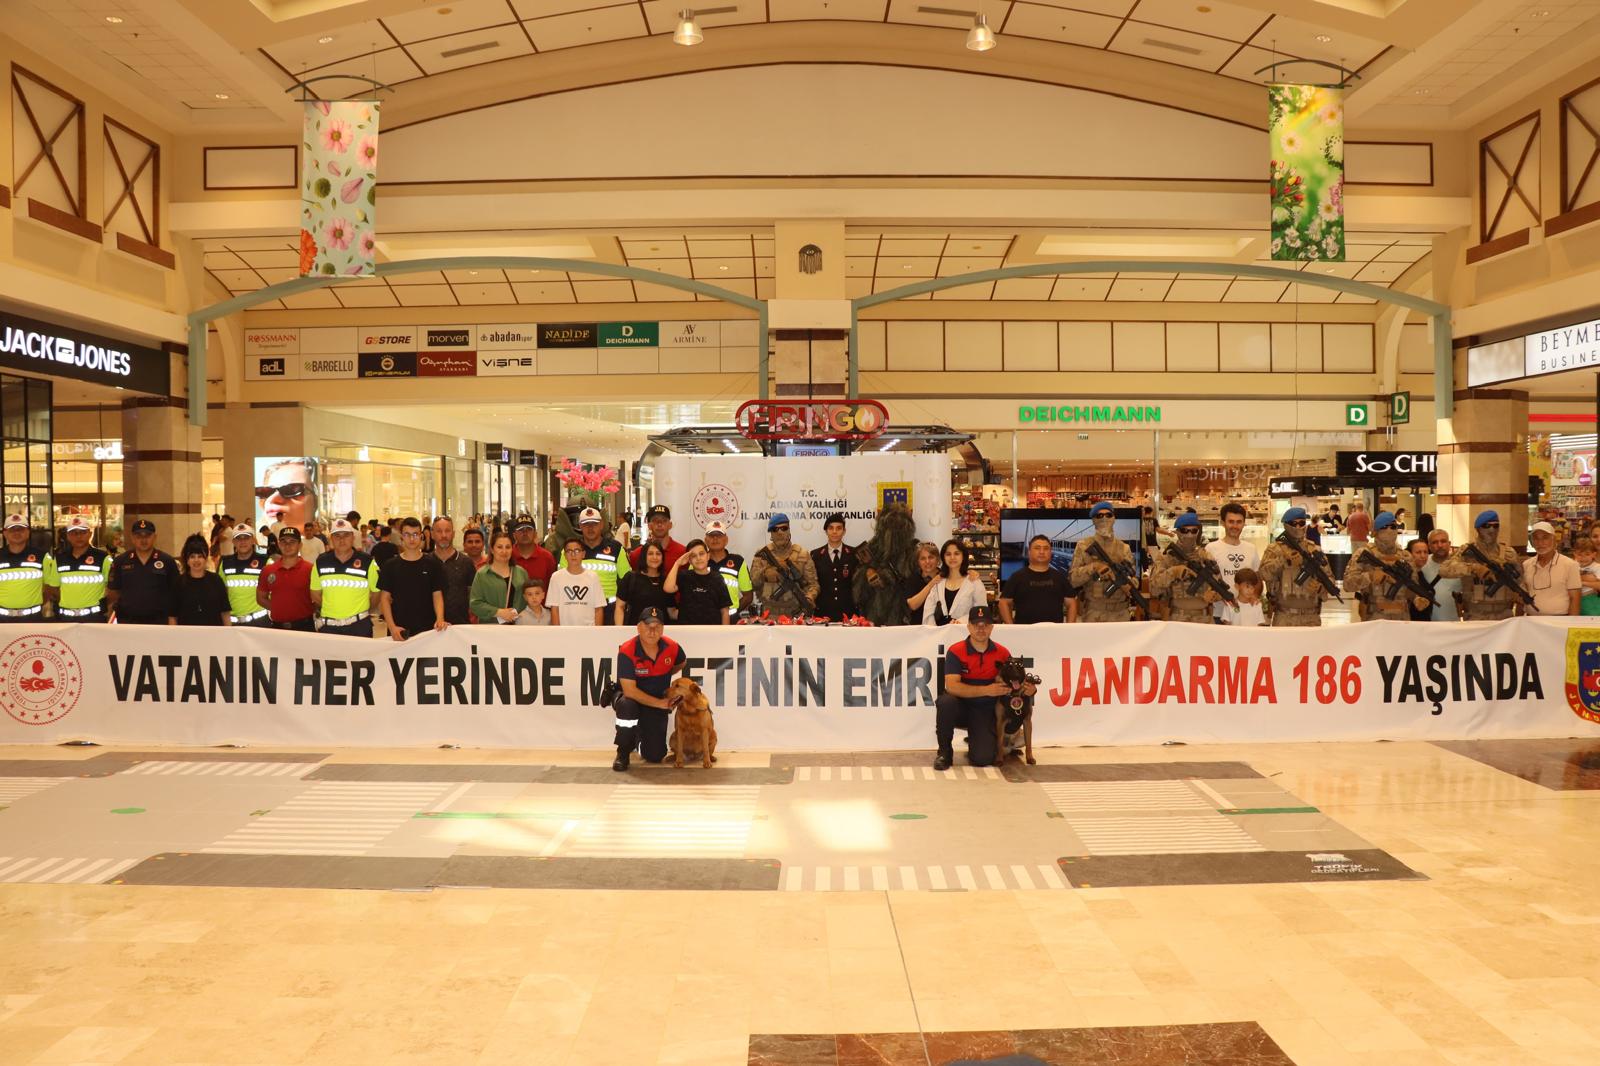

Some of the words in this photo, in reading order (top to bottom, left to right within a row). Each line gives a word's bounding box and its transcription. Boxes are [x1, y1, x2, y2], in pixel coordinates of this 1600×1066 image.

[248, 334, 296, 343] ROSSMANN
[428, 334, 469, 343] morven
[0, 326, 54, 361] JACK
[75, 344, 131, 376] JONES
[312, 360, 353, 372] BARGELLO
[1540, 350, 1598, 370] BUSINE
[1394, 395, 1406, 416] D
[1019, 406, 1161, 422] DEICHMANN
[1350, 407, 1365, 422] D
[1394, 454, 1437, 473] CHI
[800, 490, 818, 498] T.C.
[770, 501, 803, 509] ADANA
[806, 499, 847, 508] VALİLİĞİ
[741, 510, 750, 520] İL
[108, 654, 279, 705] VATANIN
[294, 658, 376, 705] HER
[389, 644, 566, 705] YERİNDE
[581, 644, 826, 707] METİNİN
[1049, 655, 1278, 707] JANDARMA
[1293, 655, 1362, 705] 186
[1376, 652, 1544, 715] YAŞINDA
[1569, 692, 1600, 722] JAND
